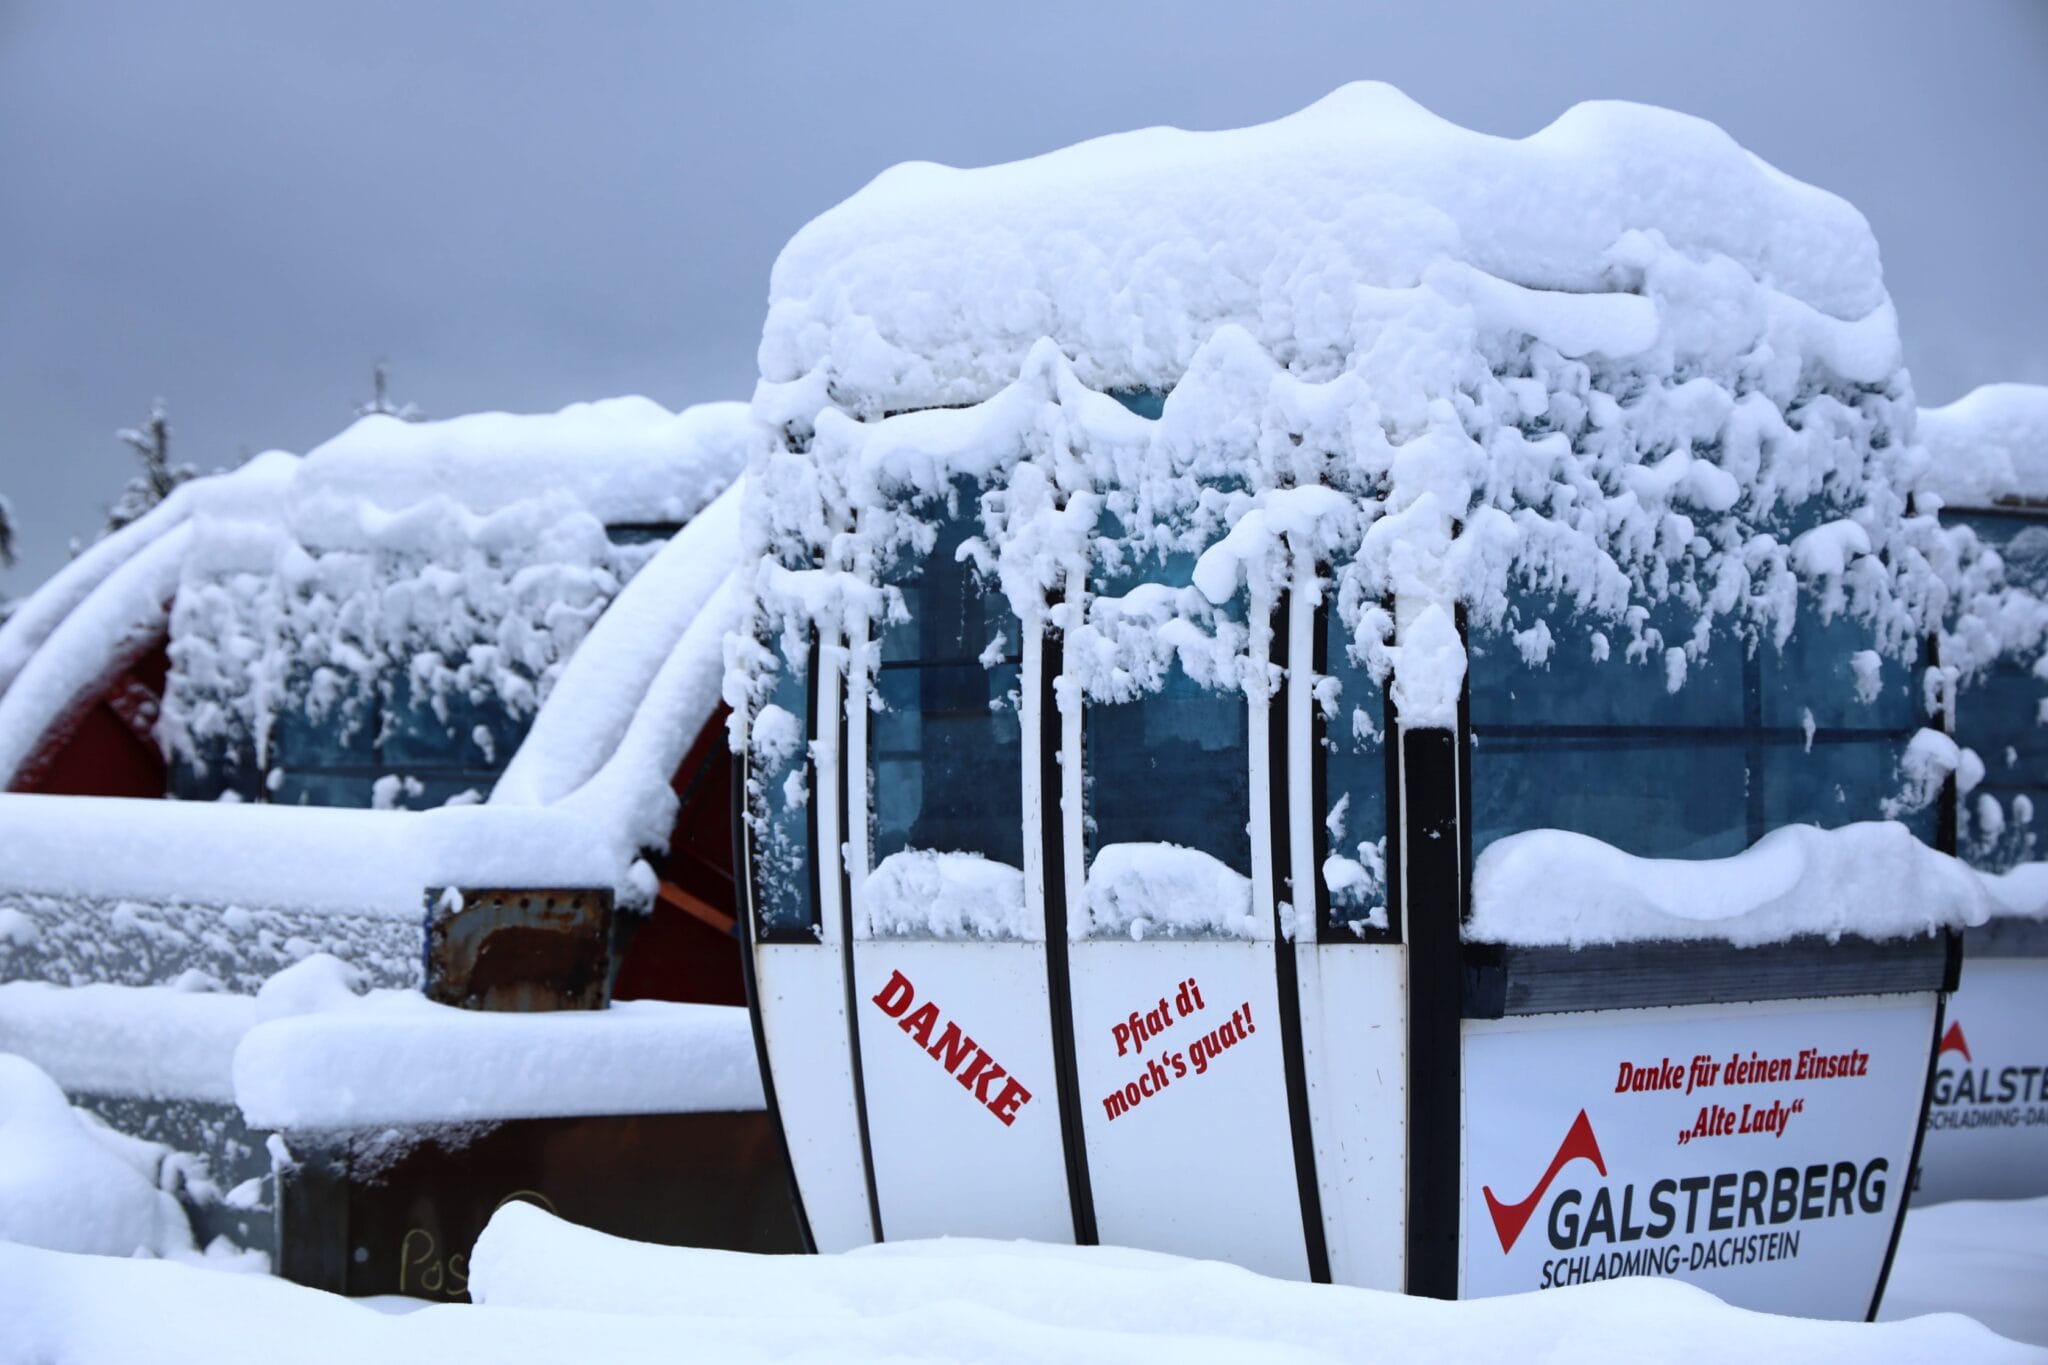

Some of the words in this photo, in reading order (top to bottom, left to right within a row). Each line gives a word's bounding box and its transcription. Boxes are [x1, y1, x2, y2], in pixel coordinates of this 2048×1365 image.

[872, 969, 1032, 1127] DANKE
[1111, 998, 1174, 1057] Pfiat
[1176, 977, 1205, 1018] di
[1189, 1002, 1256, 1075] guat!
[1615, 1057, 1684, 1093] Danke
[1686, 1054, 1720, 1095] für
[1723, 1051, 1791, 1086] deinen
[1794, 1048, 1869, 1080] Einsatz
[1547, 1156, 1888, 1250] GALSTERBERG
[1540, 1230, 1800, 1290] SCHLADMING-DACHSTEIN
